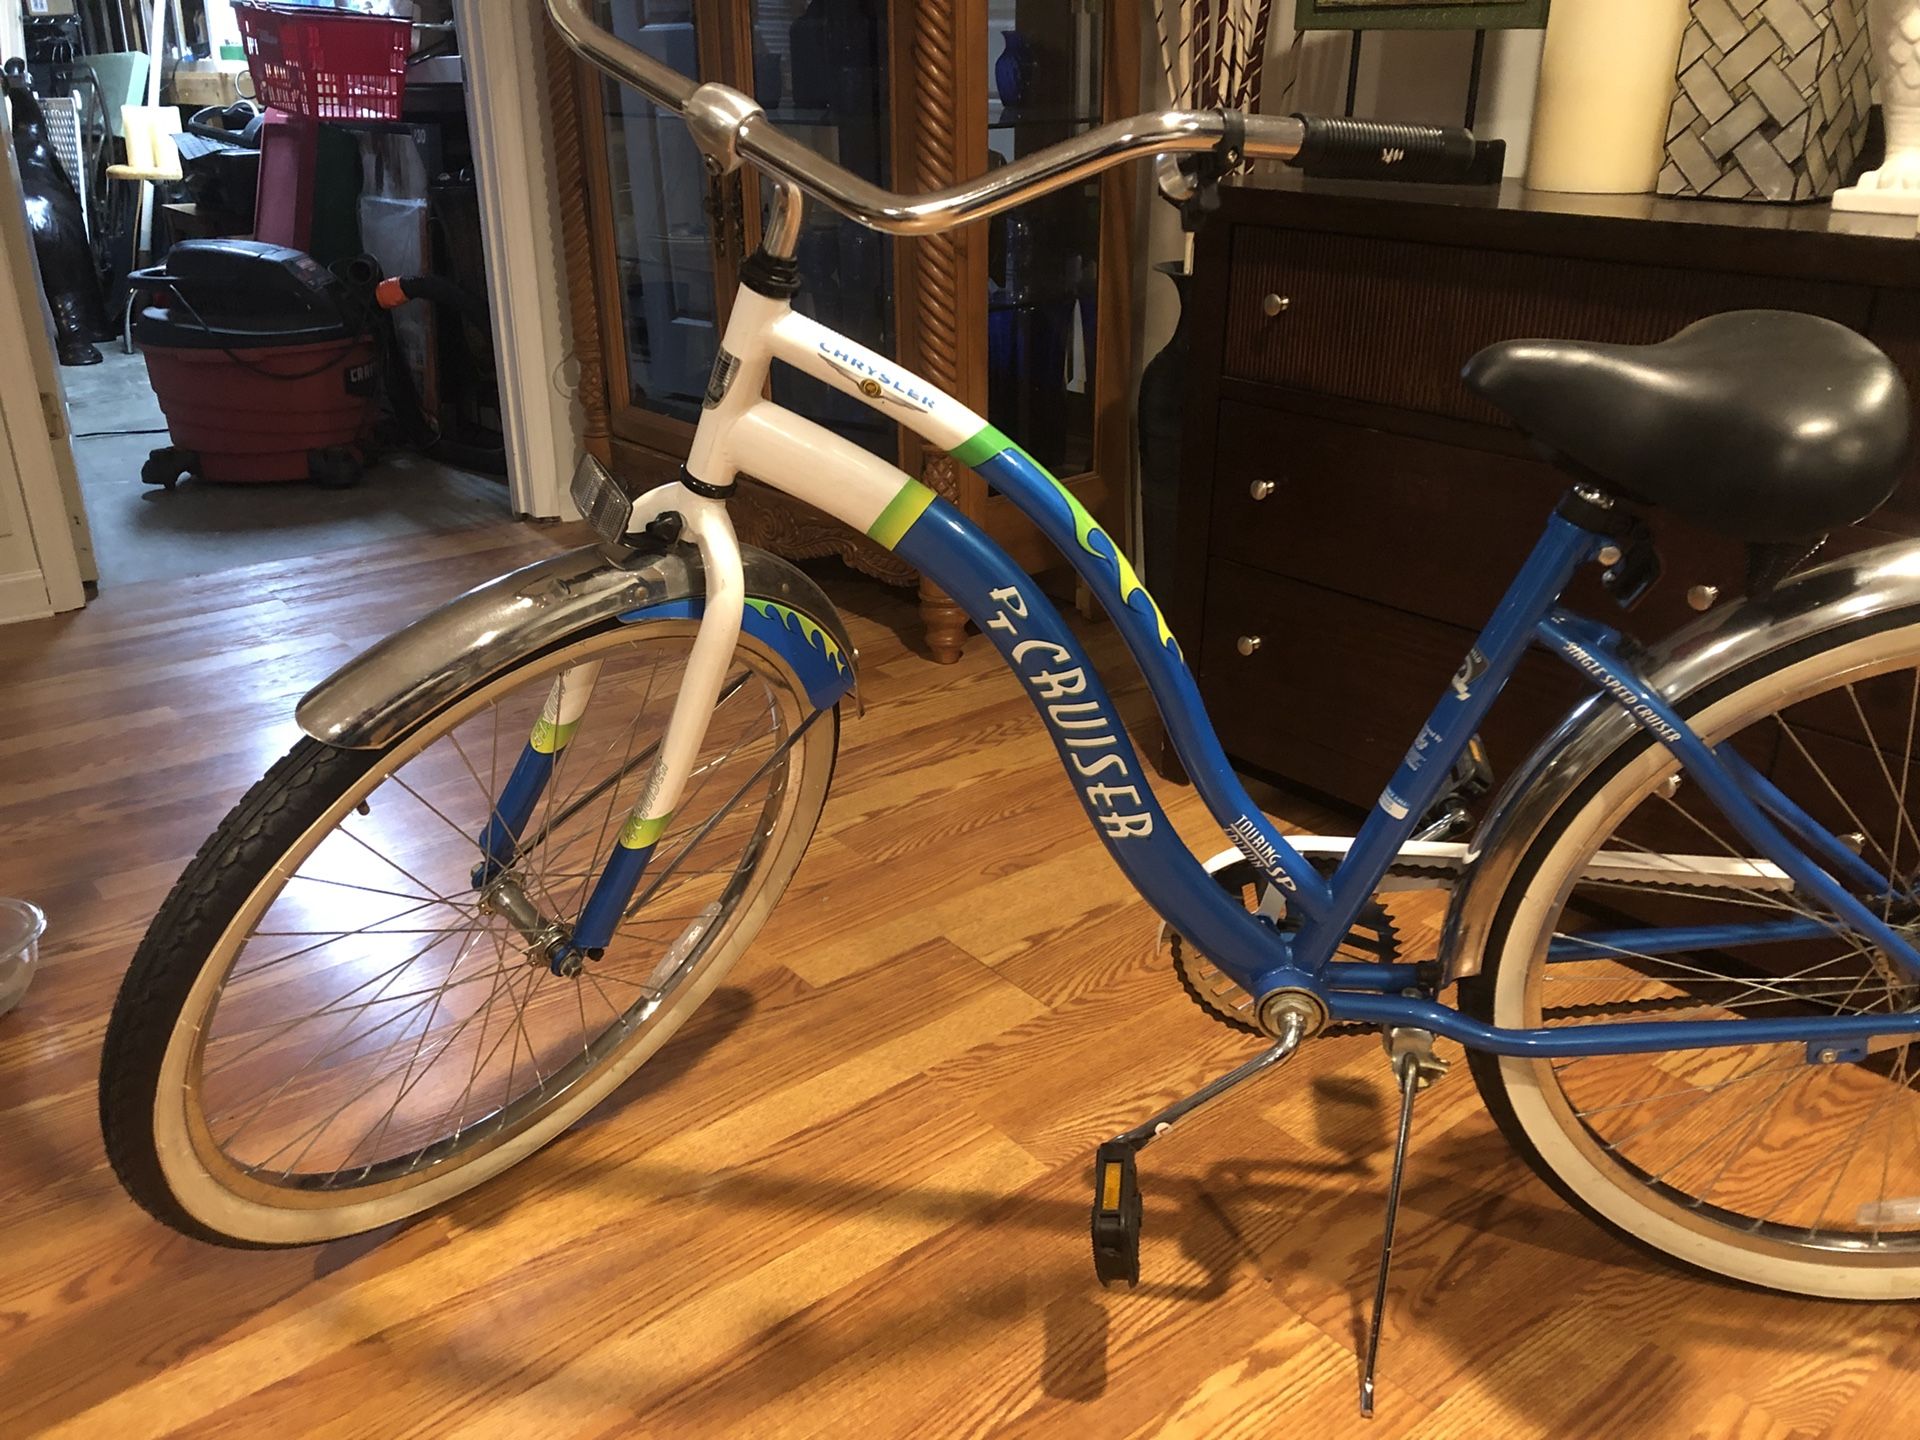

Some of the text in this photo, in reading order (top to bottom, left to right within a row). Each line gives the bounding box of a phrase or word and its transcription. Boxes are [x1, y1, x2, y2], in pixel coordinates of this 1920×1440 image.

[819, 342, 936, 409] CHRYSLER
[986, 585, 1153, 838] PT CRUISER
[1562, 641, 1682, 742] SINGLE SPEED CRUISER
[1234, 813, 1282, 865] TOURING
